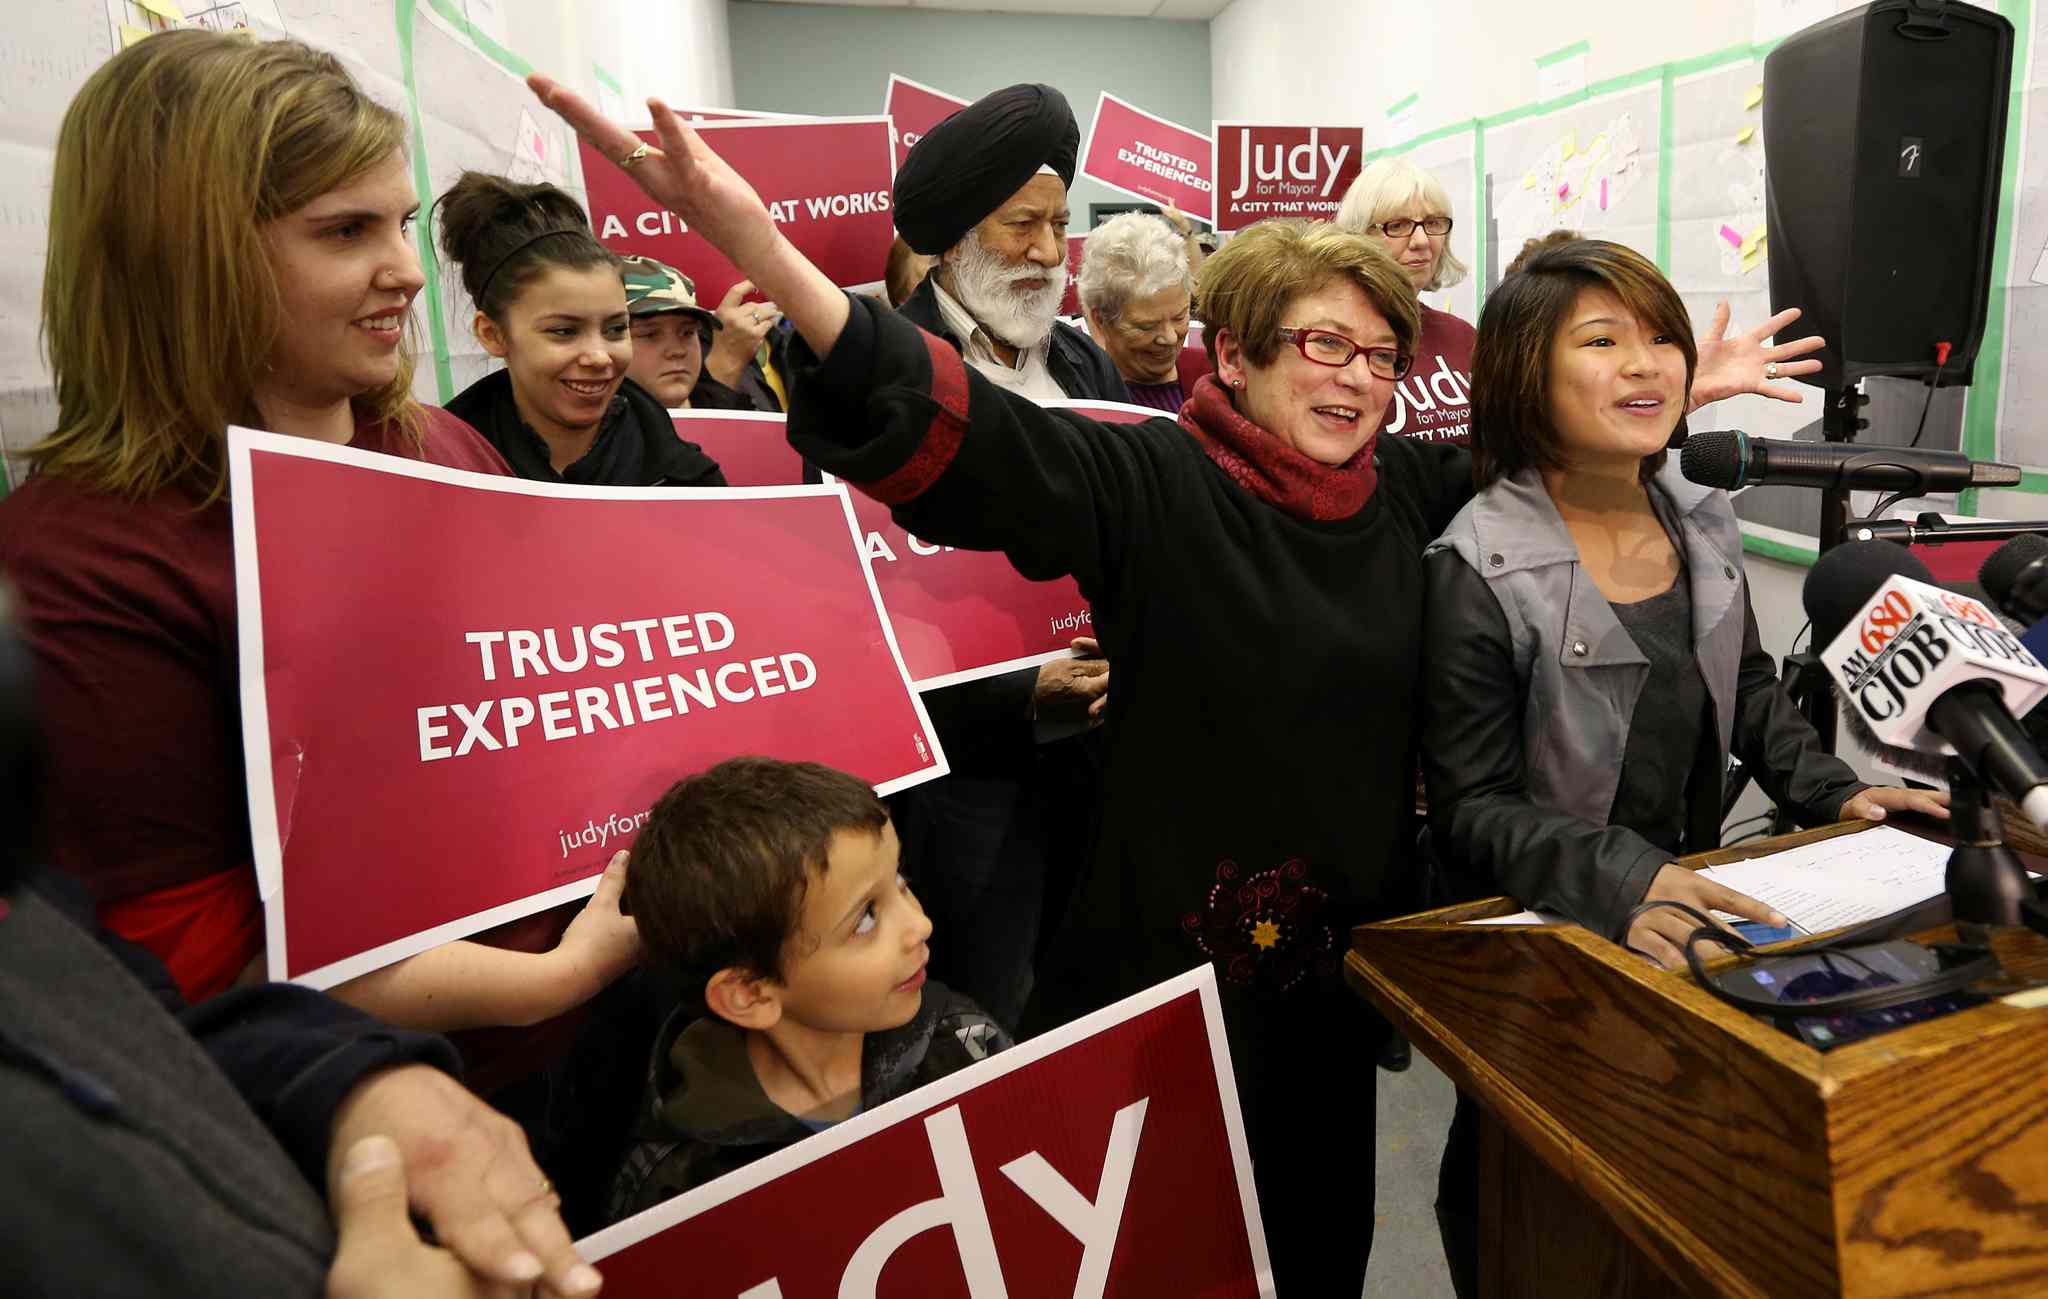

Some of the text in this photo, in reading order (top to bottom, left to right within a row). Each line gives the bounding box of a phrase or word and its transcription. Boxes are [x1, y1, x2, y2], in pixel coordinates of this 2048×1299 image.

[1117, 148, 1212, 192] EXPERIENCED
[1134, 141, 1198, 173] TRUSTED
[1231, 127, 1350, 200] Judy
[1230, 201, 1344, 213] A CITY THAT WORK
[1256, 181, 1317, 197] for Mayor
[601, 190, 890, 239] A CI AT WORKS
[1416, 412, 1436, 424] for
[1436, 424, 1469, 439] THAT
[465, 611, 735, 681] TRUSTED
[1841, 648, 1873, 690] AM
[1861, 590, 1914, 655] 680
[1860, 623, 1950, 721] CJOB
[416, 652, 817, 762] EXPERIENCED
